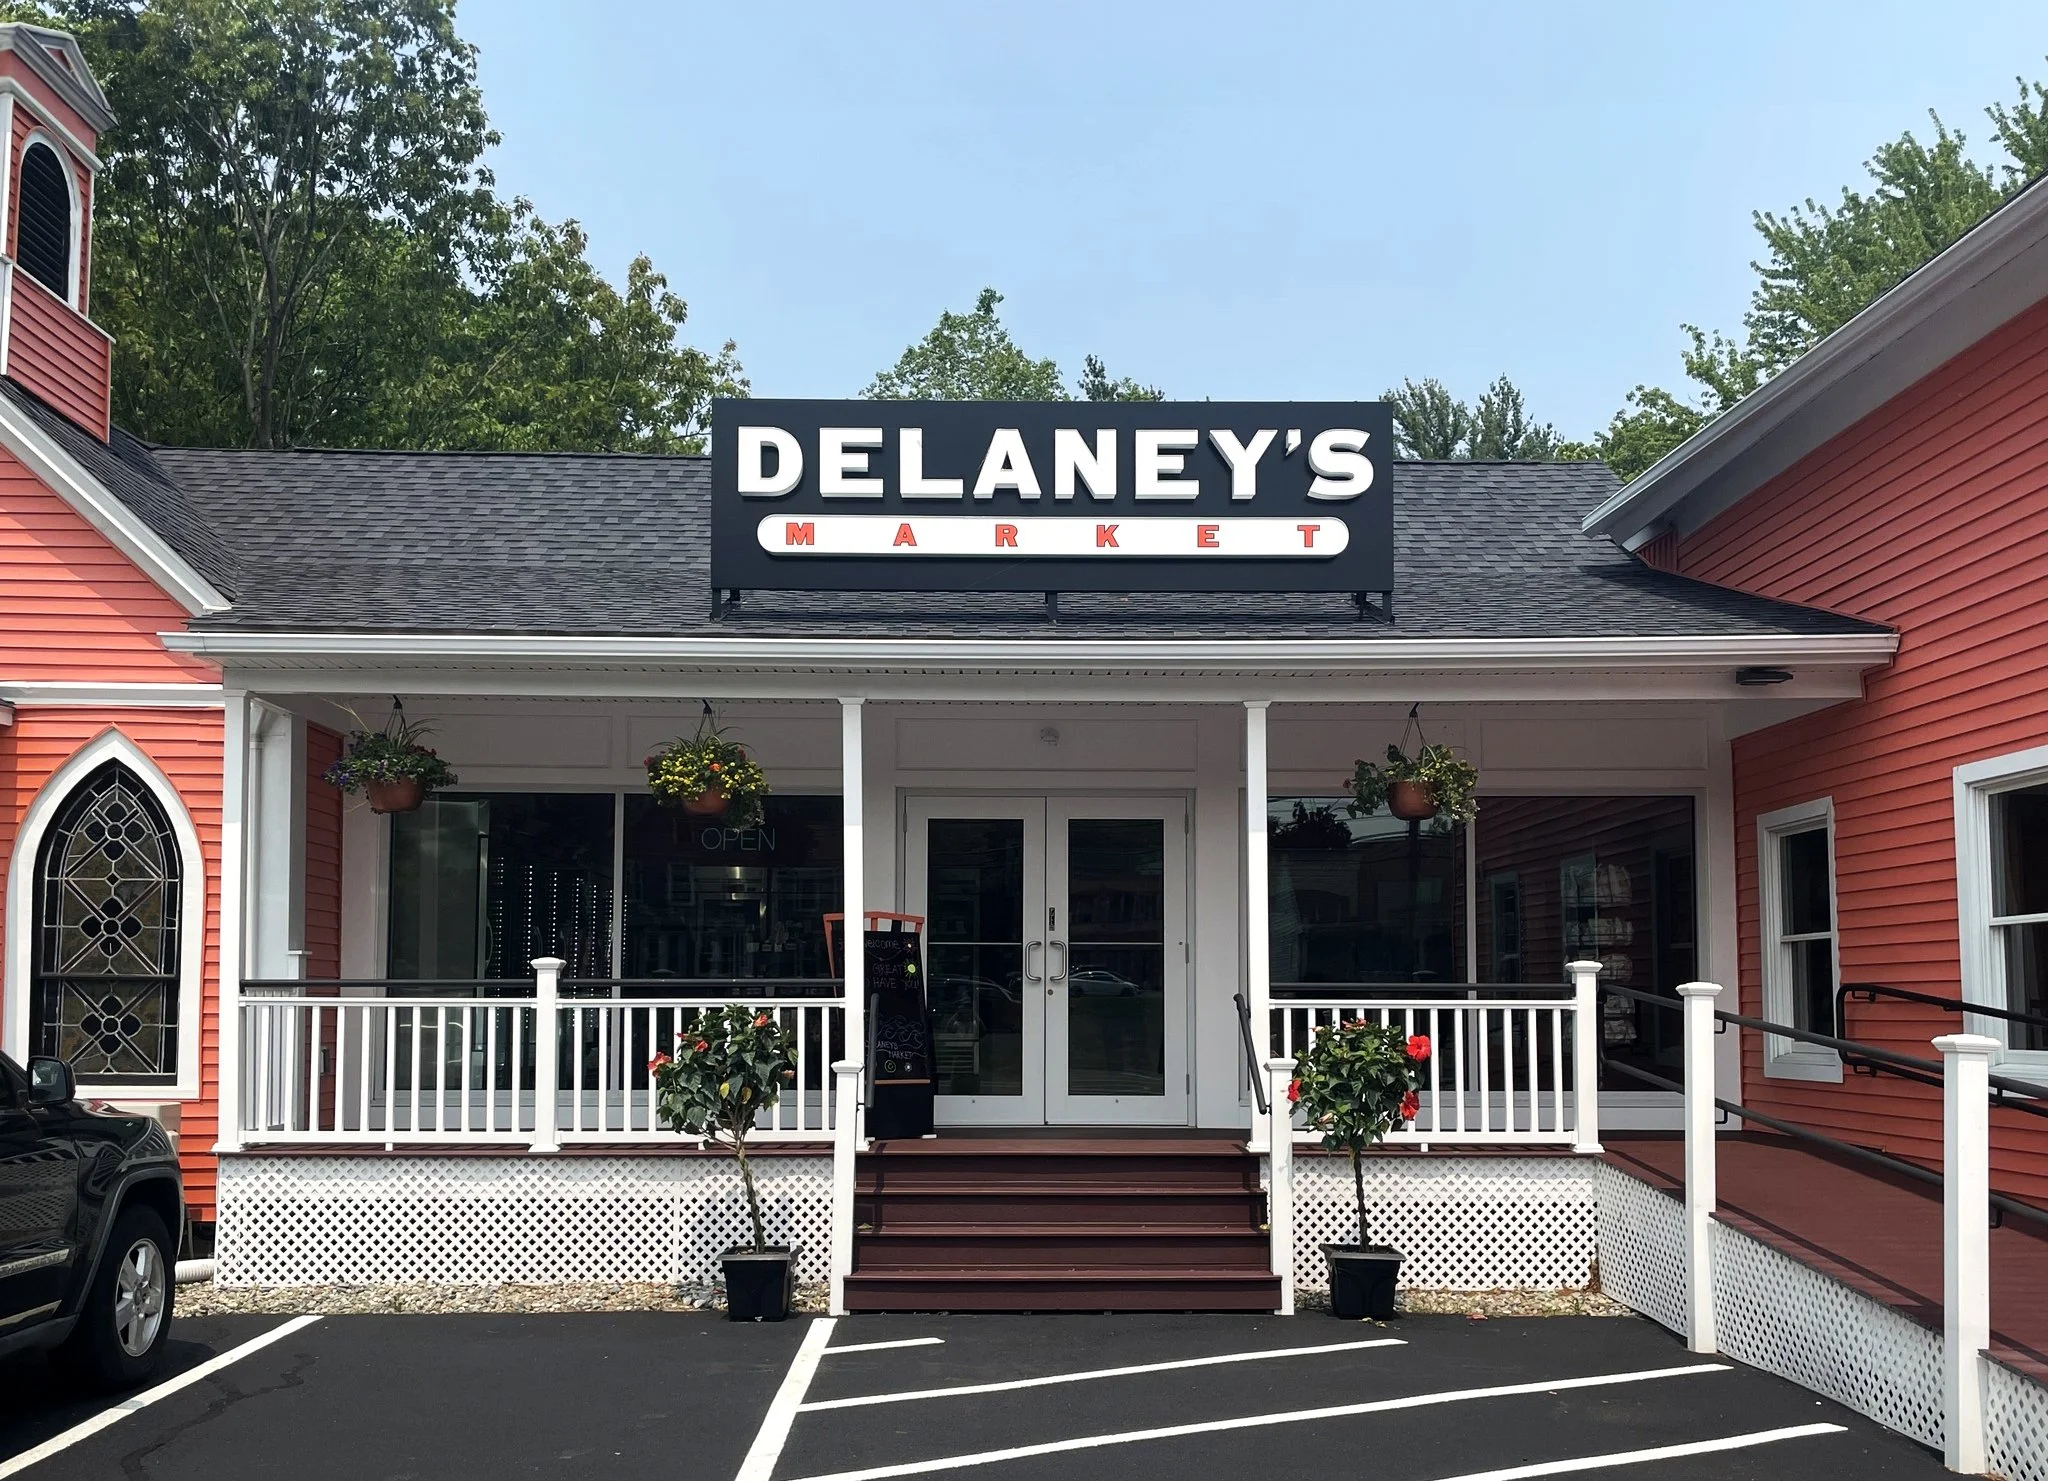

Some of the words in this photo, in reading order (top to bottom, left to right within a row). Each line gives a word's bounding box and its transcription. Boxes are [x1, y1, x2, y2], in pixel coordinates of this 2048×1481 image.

[737, 425, 1374, 500] DELANEY'S
[785, 522, 1320, 548] MARKET
[701, 827, 775, 850] OPEN
